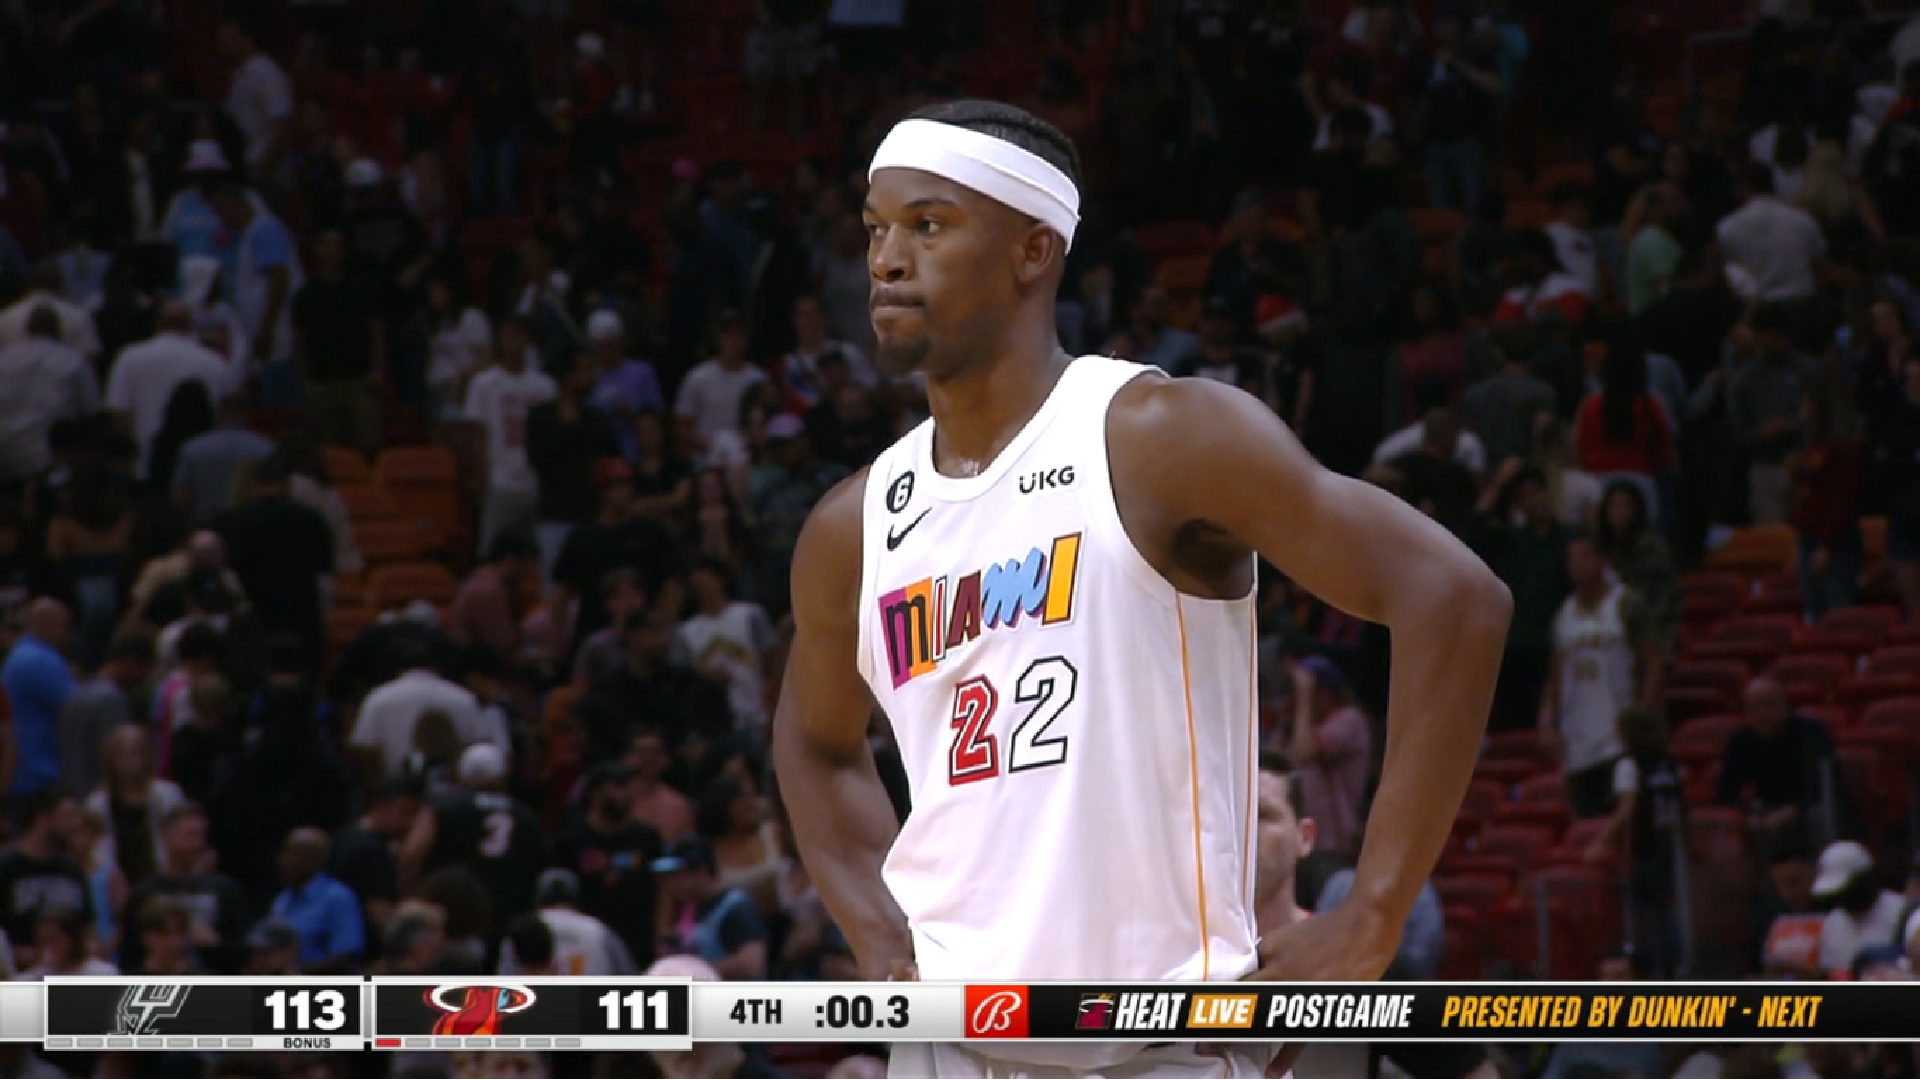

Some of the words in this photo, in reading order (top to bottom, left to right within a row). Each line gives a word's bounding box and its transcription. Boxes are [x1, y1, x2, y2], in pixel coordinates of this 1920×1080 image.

[1019, 466, 1075, 494] UKG
[949, 655, 1078, 786] 22
[480, 811, 514, 857] 3
